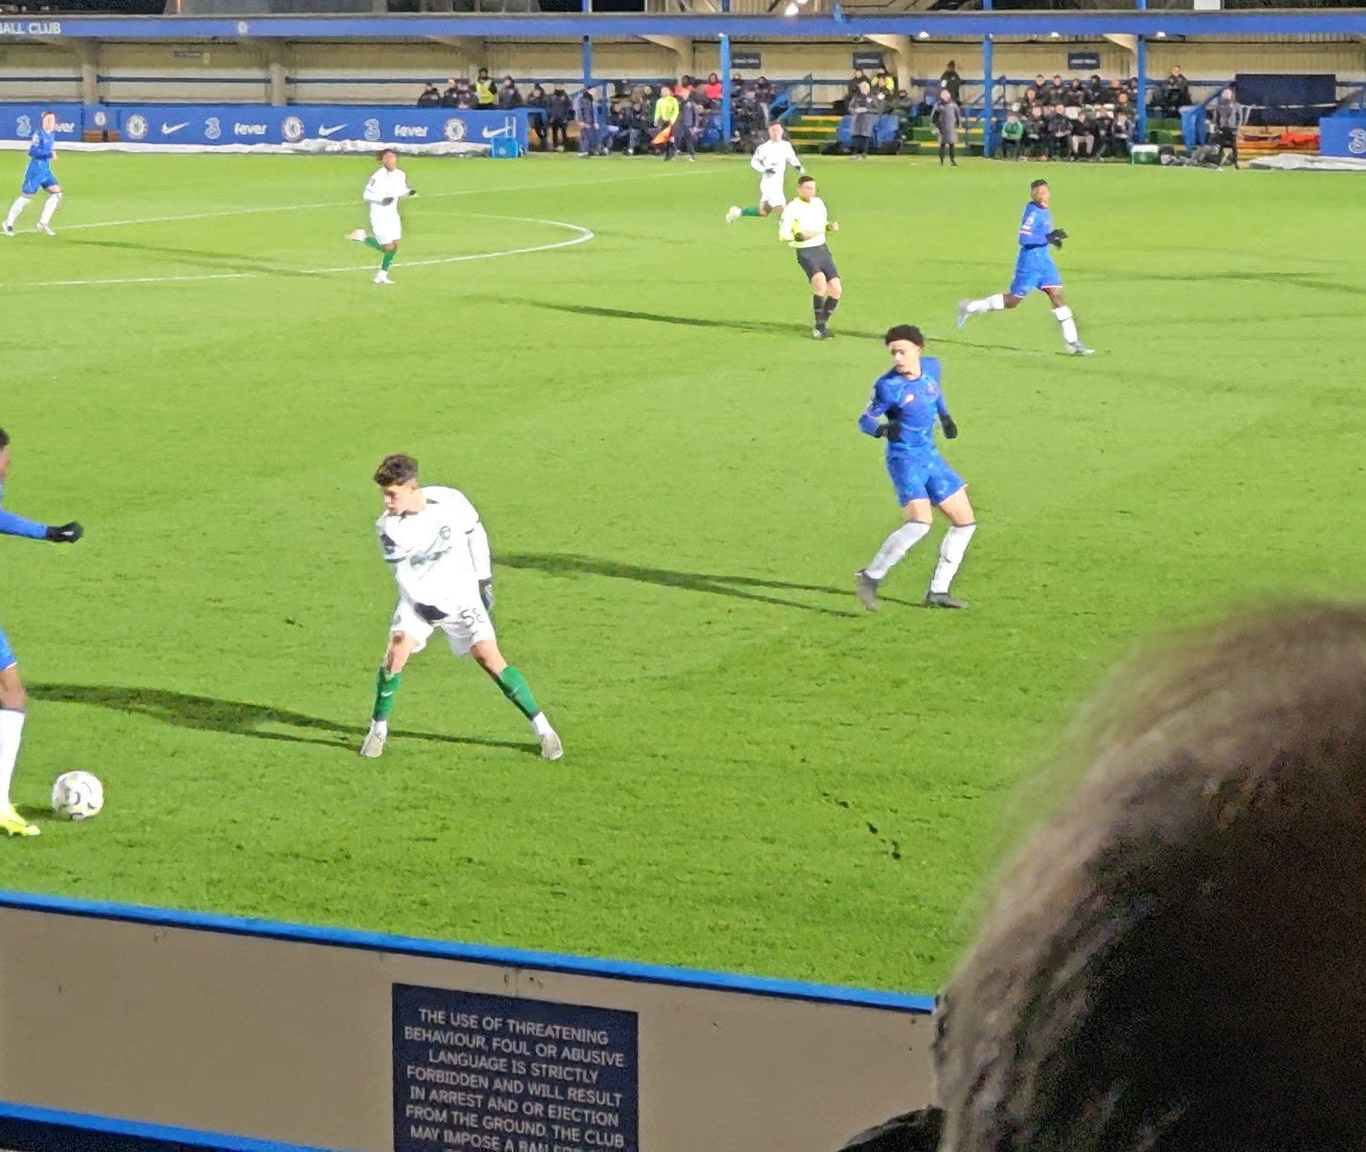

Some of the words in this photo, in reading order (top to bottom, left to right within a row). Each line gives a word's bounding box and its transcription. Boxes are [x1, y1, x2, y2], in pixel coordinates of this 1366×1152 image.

[28, 22, 62, 35] CLUB
[234, 122, 267, 136] fever
[394, 124, 429, 137] fever
[419, 1008, 446, 1024] THE
[450, 1013, 478, 1029] USE
[482, 1016, 503, 1030] OF
[507, 1019, 608, 1045] THREATENING
[429, 1050, 508, 1072] LANGUAGE
[512, 1061, 526, 1074] IS
[531, 1063, 599, 1084] STRICTLY
[492, 1039, 531, 1056] FOUL
[536, 1044, 556, 1058] OR
[561, 1046, 625, 1068] ABUSIVE
[407, 1065, 489, 1089] FORBIDDEN
[492, 1078, 523, 1094] AND
[528, 1081, 563, 1099] WILL
[568, 1089, 623, 1108] RESULT
[410, 1086, 425, 1100] IN
[429, 1089, 484, 1108] ARREST
[487, 1097, 519, 1113] AND
[522, 1101, 544, 1116] OR
[548, 1106, 619, 1127] EJECTION
[406, 1105, 447, 1123] FROM
[451, 1111, 479, 1128] THE
[552, 1124, 581, 1142] THE
[585, 1130, 624, 1148] CLUB
[410, 1125, 439, 1141] MAY
[443, 1130, 500, 1151] IMPOSE
[505, 1139, 515, 1152] A
